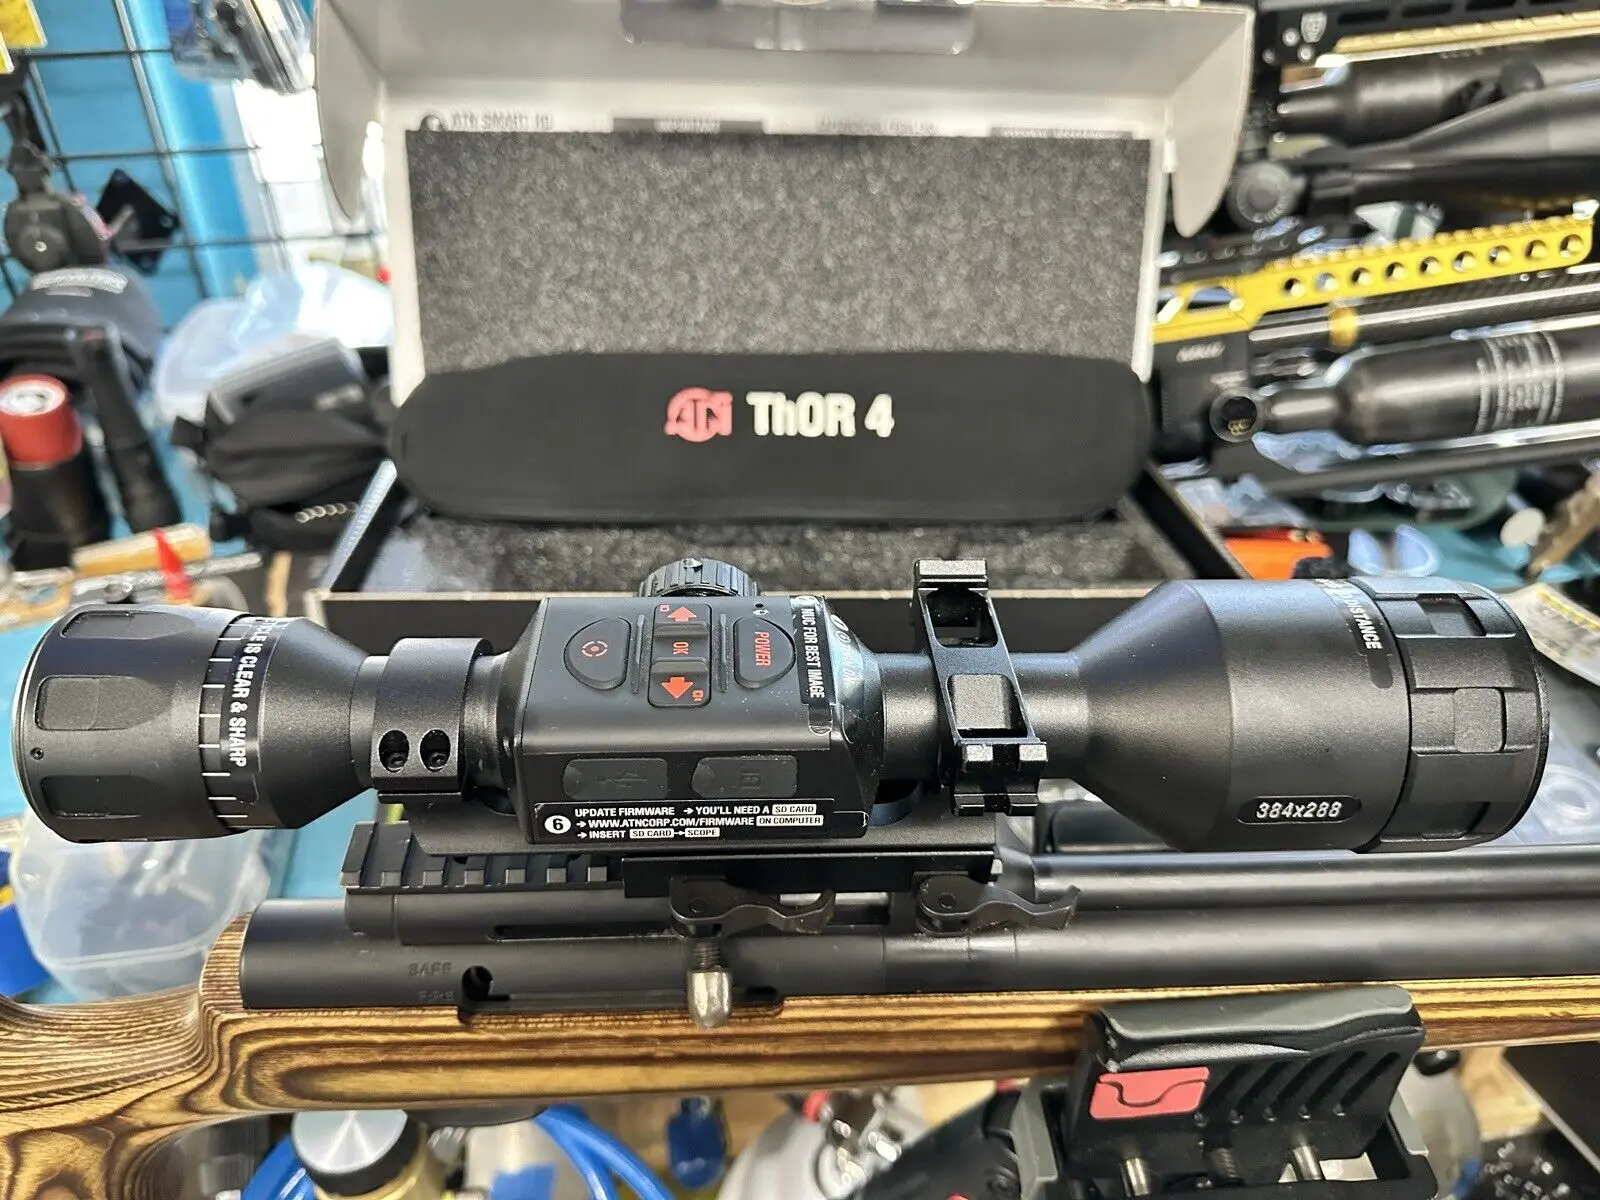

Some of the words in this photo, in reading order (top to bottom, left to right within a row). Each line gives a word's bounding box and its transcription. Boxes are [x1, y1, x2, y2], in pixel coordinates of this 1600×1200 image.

[746, 391, 856, 437] ThOR
[864, 393, 895, 437] 4
[803, 627, 818, 644] FOR
[244, 643, 264, 654] IS
[673, 642, 689, 655] OK
[754, 632, 773, 668] POWER
[805, 645, 821, 668] BEST
[232, 656, 258, 698] CLEAR
[808, 669, 825, 698] IMAGE
[230, 703, 248, 713] &
[229, 717, 247, 767] SHARP
[575, 808, 617, 817] UPDATE
[619, 807, 675, 816] FIRMWARE
[696, 806, 732, 815] YOU'LL
[734, 805, 760, 815] NEED
[762, 805, 770, 814] A
[775, 805, 788, 813] SD
[790, 804, 814, 813] CARD
[1256, 801, 1342, 819] 384x288
[588, 817, 755, 828] WWW.ATNCORP.COM/FIRMWARE
[760, 816, 771, 824] ON
[773, 816, 821, 824] COMPUTER
[589, 830, 626, 839] INSERT
